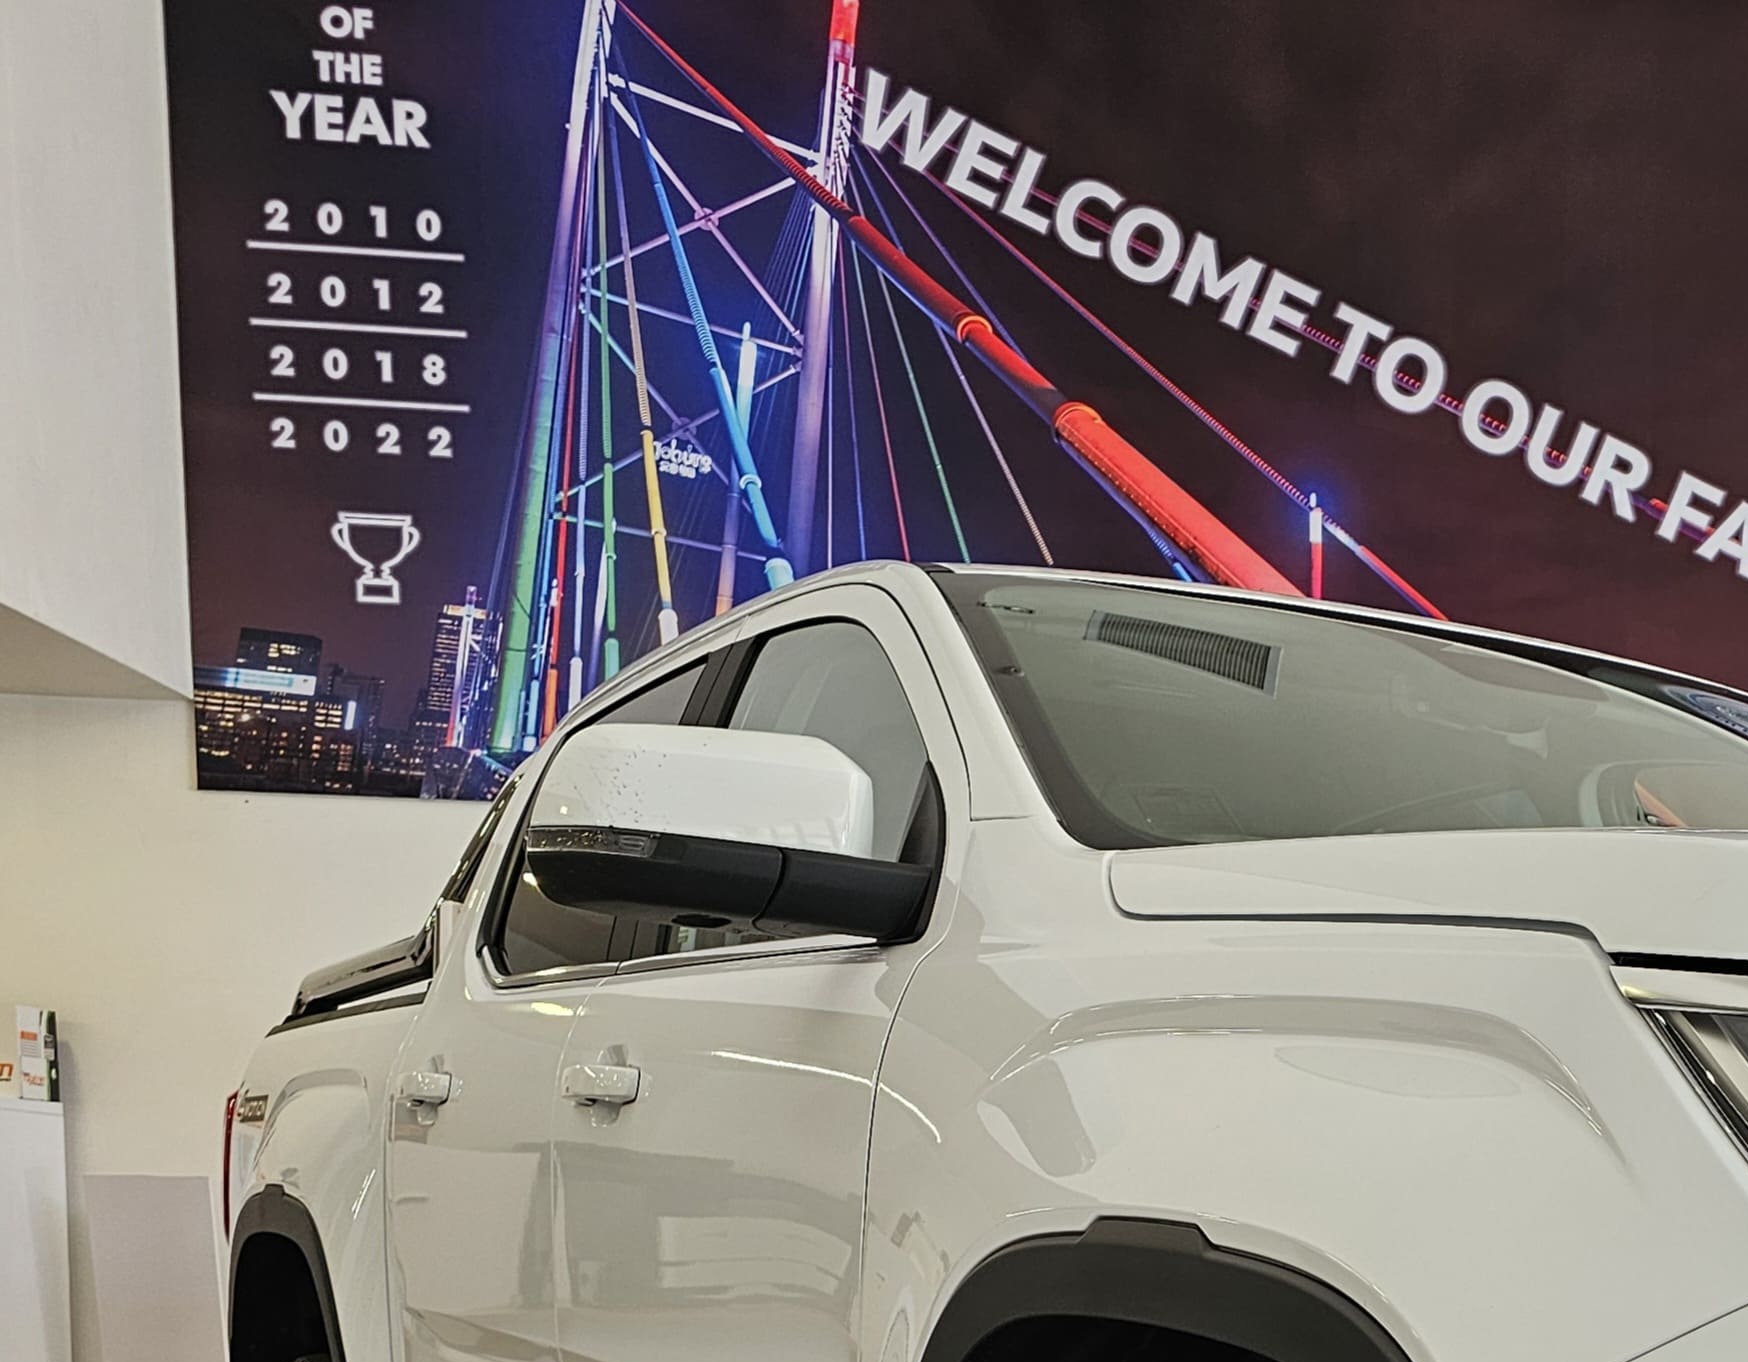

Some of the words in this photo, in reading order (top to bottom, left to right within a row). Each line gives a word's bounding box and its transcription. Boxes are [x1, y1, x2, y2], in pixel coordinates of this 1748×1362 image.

[320, 5, 374, 40] OF
[312, 50, 384, 87] THE
[269, 90, 431, 149] YEAR
[264, 200, 442, 241] 2010
[267, 273, 444, 314] 2012
[858, 67, 1323, 358] WELCOME
[1330, 299, 1448, 415] TO
[1459, 378, 1652, 523] OUR
[269, 345, 447, 385] 2018
[270, 417, 453, 458] 2022
